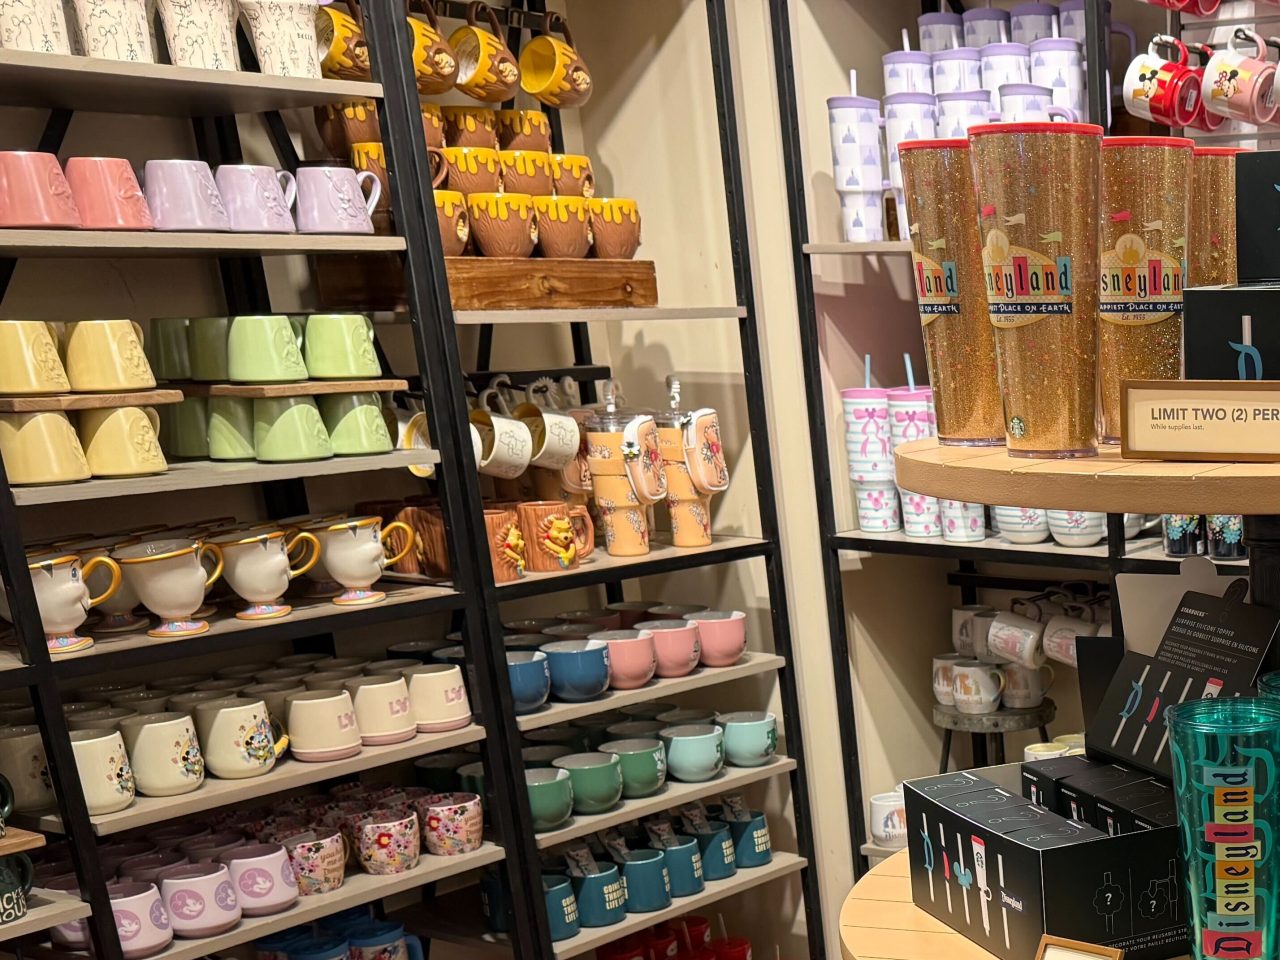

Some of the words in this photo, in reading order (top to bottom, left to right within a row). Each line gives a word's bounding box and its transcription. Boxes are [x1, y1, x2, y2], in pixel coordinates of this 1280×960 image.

[999, 304, 1021, 312] PLACE
[1040, 304, 1070, 313] EARTH
[1127, 302, 1153, 311] PLACE
[1150, 408, 1190, 420] LIMIT
[1193, 408, 1227, 420] TWO
[1231, 407, 1248, 423] (2)
[1253, 408, 1280, 421] PER
[1168, 423, 1192, 432] supplies
[1212, 770, 1259, 956] Disneyland
